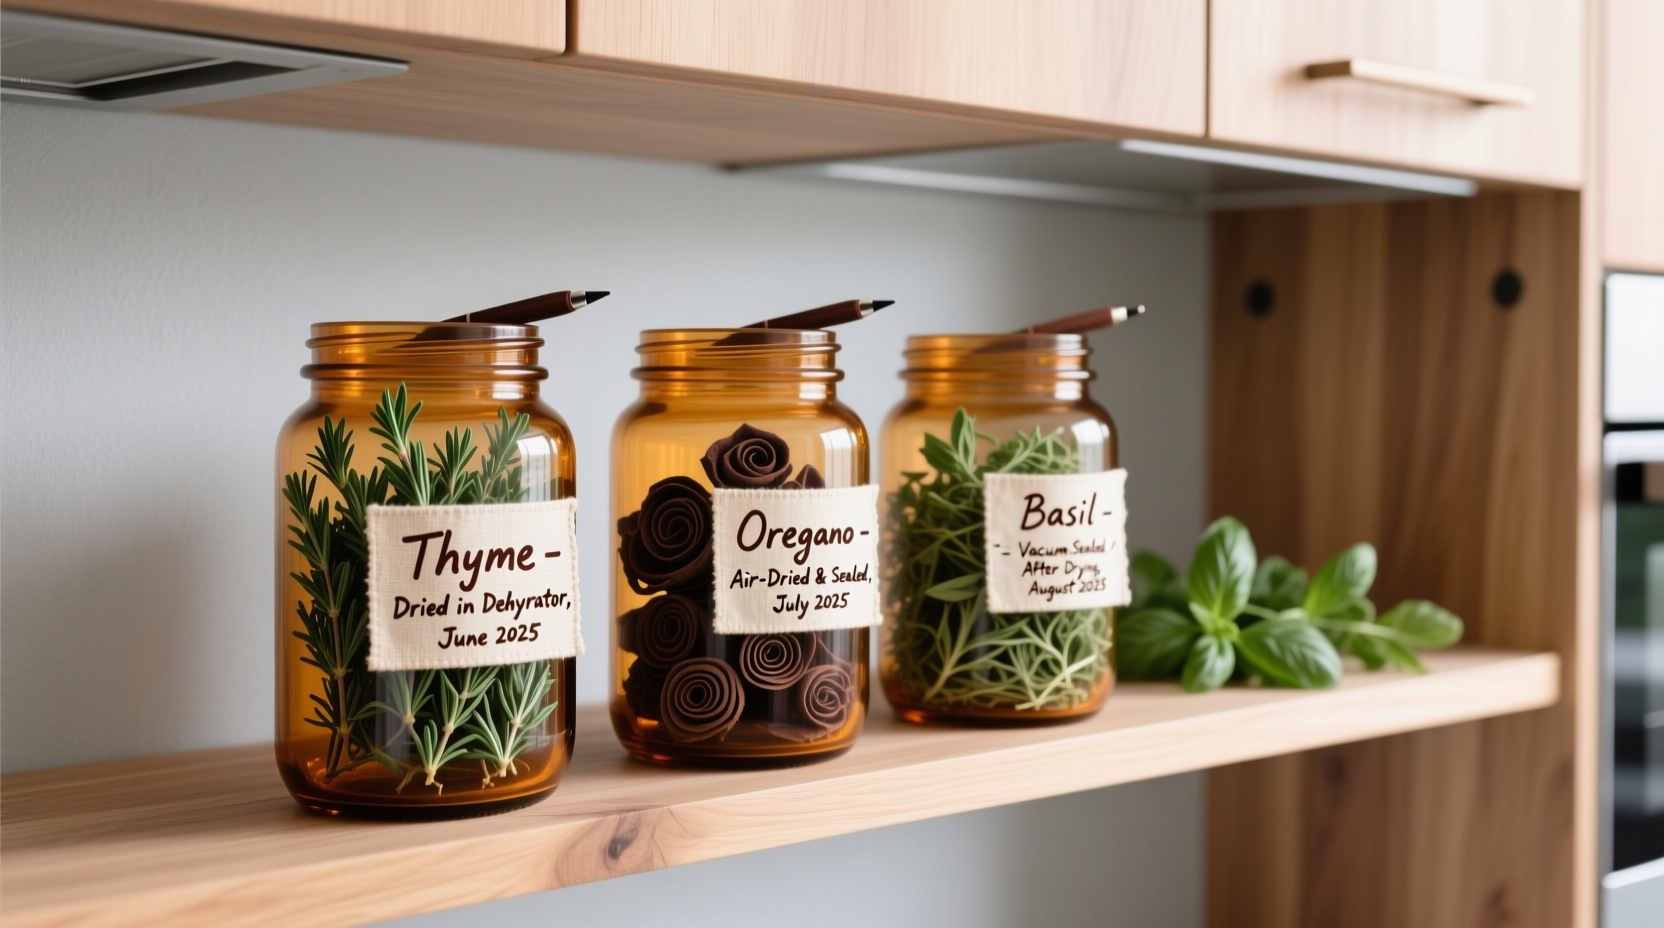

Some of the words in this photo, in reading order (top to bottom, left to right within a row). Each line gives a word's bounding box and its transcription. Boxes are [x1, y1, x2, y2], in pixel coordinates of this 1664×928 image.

[1020, 491, 1097, 531] Basil
[736, 509, 854, 566] Oregano
[401, 529, 536, 592] Thyme
[1021, 560, 1059, 577] After
[729, 566, 811, 589] Air-Dried
[814, 567, 827, 585] &
[831, 563, 872, 584] Sealed,
[1027, 580, 1076, 602] August
[1078, 577, 1107, 593] 2025
[393, 593, 451, 620] Dried
[456, 597, 475, 615] in
[482, 588, 572, 621] Dehyrator,
[772, 593, 810, 620] July
[813, 591, 850, 611] 2025
[438, 626, 488, 650] June
[495, 622, 542, 644] 2025
